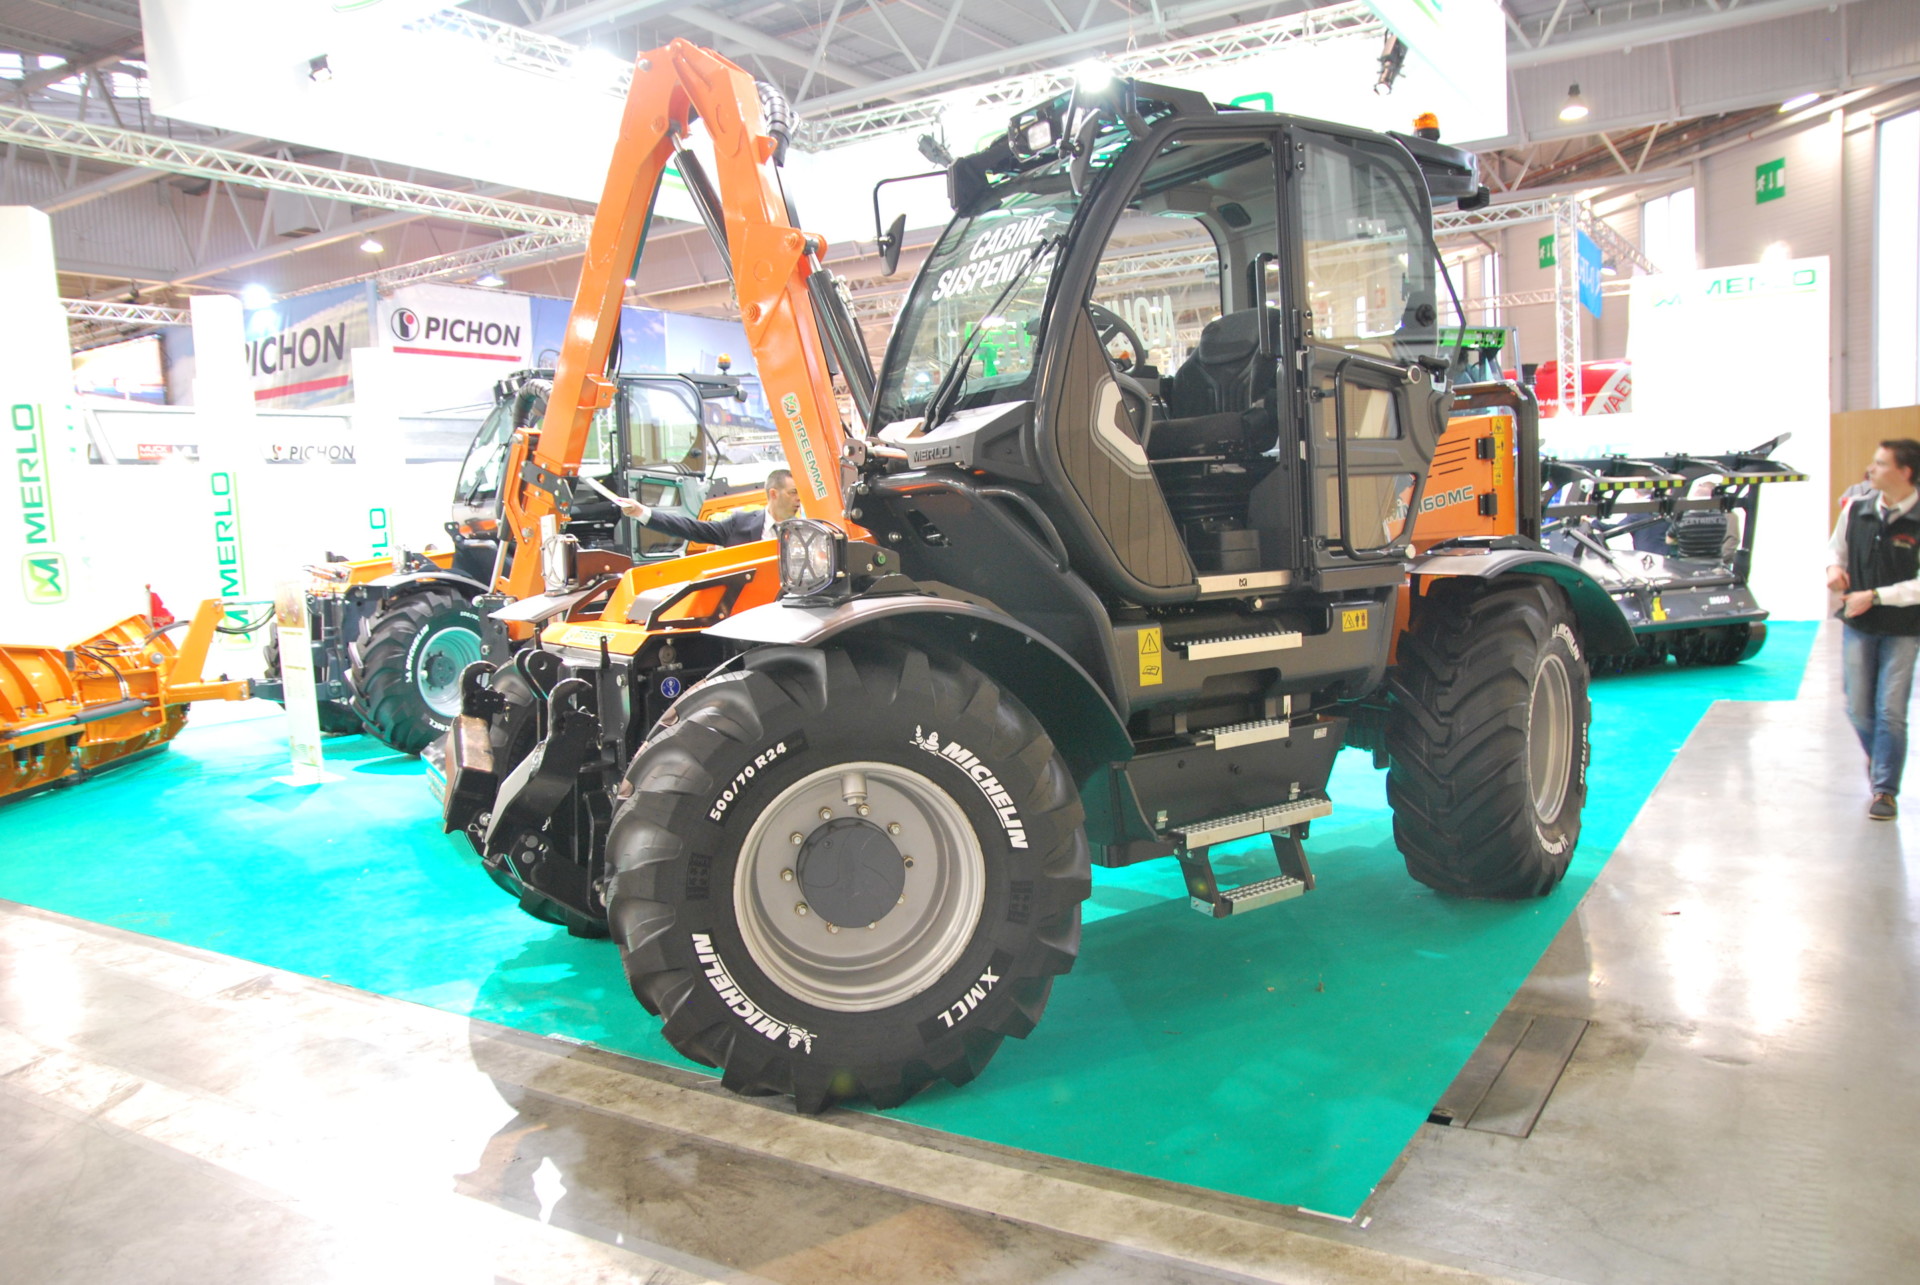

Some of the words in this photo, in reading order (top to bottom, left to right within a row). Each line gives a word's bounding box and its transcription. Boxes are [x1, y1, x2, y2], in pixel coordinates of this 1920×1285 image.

[969, 211, 1056, 261] CABINE
[931, 247, 1057, 301] SUSPENDE
[1706, 269, 1817, 295] MEO
[425, 316, 521, 347] PICHON
[11, 403, 48, 544] MERLO
[290, 445, 355, 460] PICHON
[913, 446, 952, 463] MERLO
[211, 472, 240, 597] MERLO
[709, 765, 755, 821] 500/70
[754, 742, 787, 769] R24
[941, 741, 1029, 849] MICHELIN
[692, 934, 786, 1041] MICHELIN
[937, 965, 1000, 1028] XMCL
